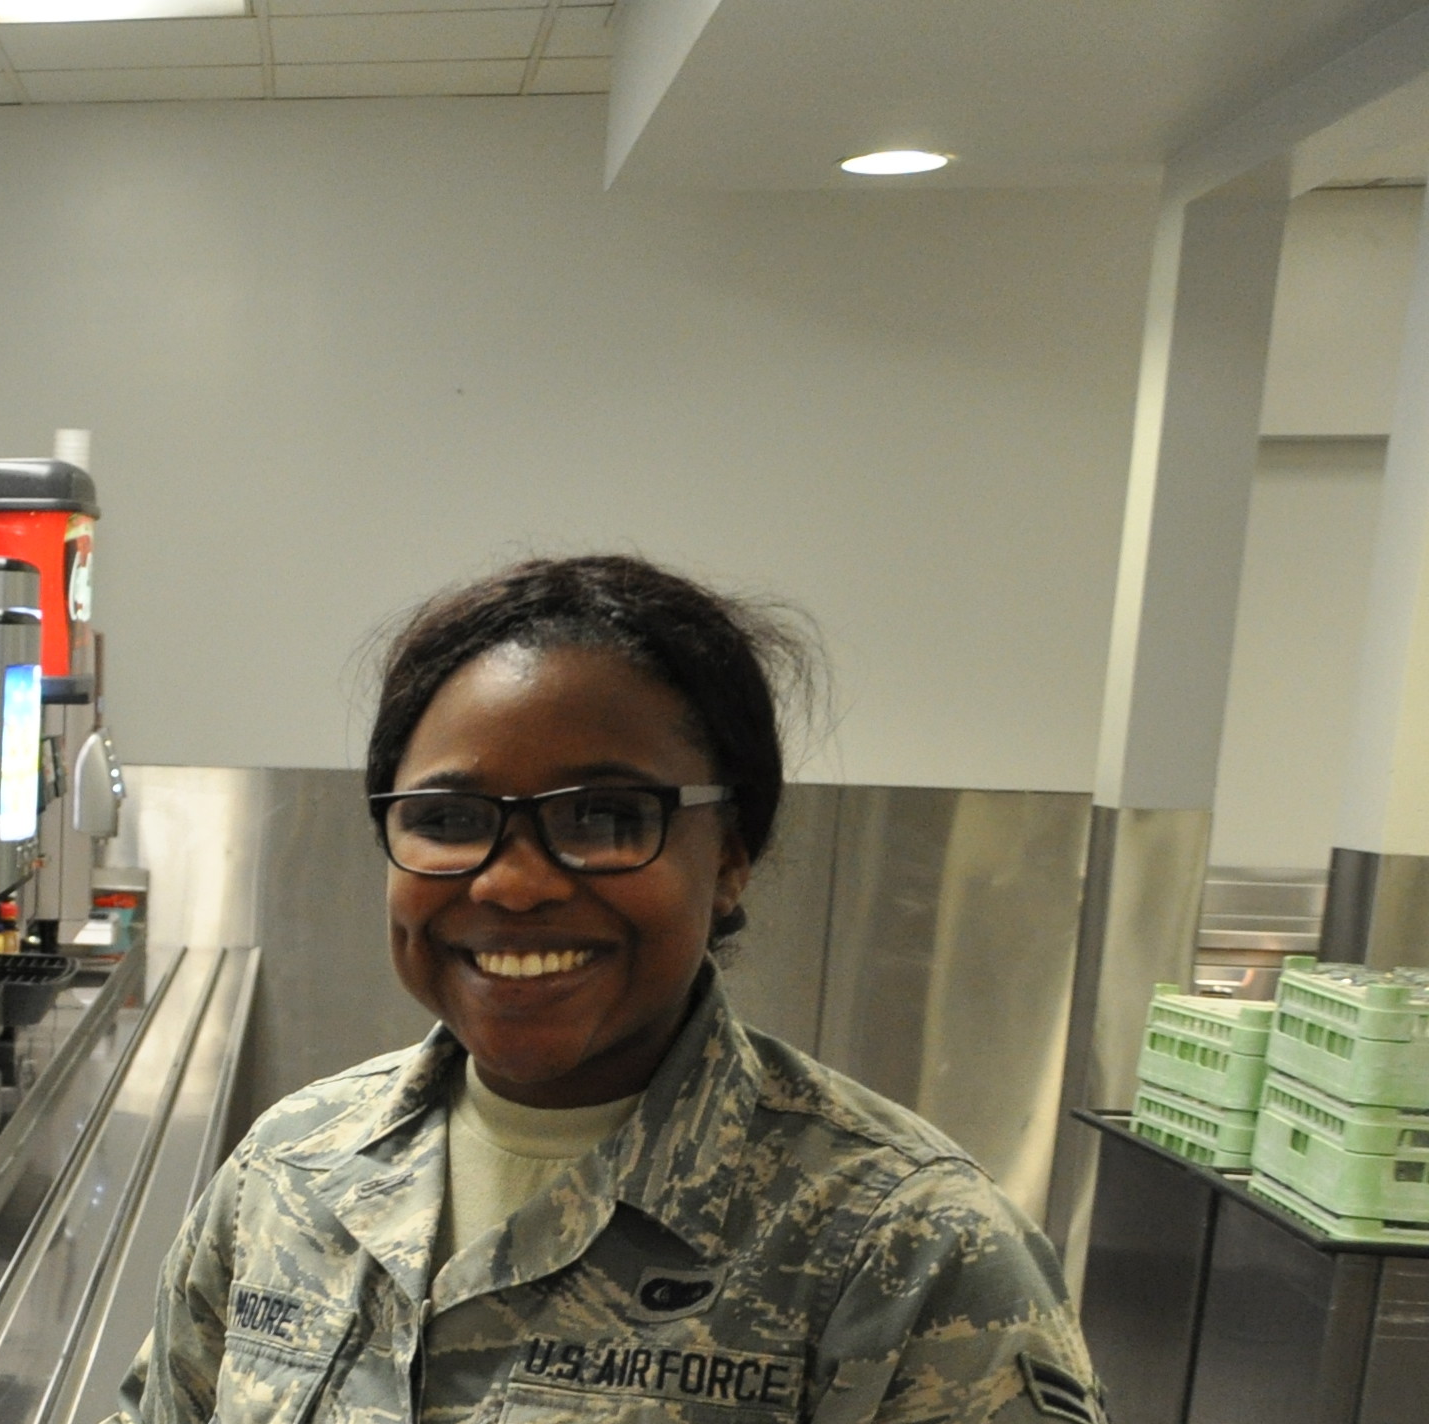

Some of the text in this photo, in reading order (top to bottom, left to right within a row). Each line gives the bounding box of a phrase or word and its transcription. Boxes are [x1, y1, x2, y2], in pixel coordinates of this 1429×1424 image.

[234, 1288, 299, 1338] MOORE
[524, 1338, 791, 1405] U.S. AIR FORCE
